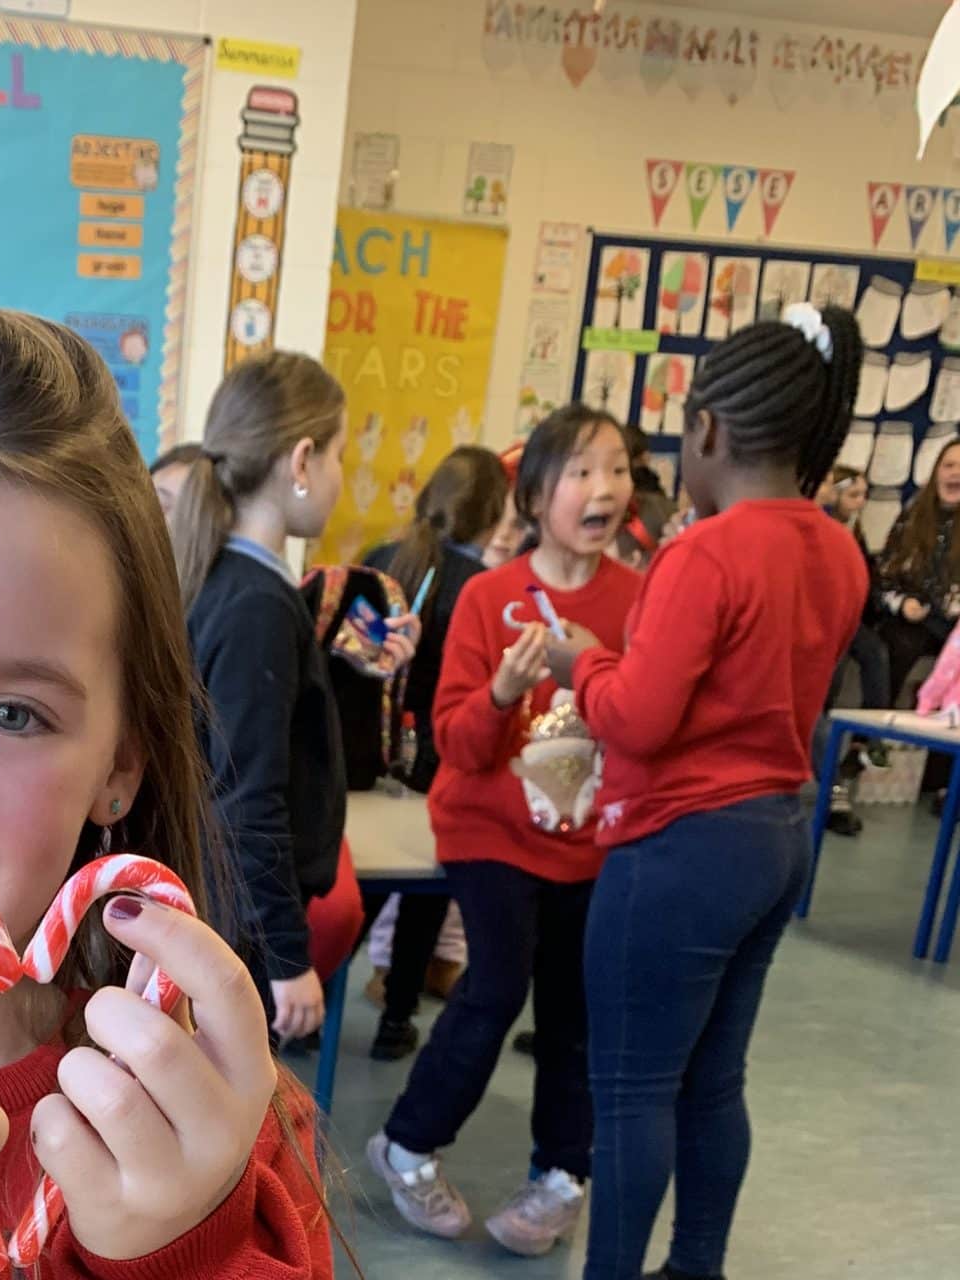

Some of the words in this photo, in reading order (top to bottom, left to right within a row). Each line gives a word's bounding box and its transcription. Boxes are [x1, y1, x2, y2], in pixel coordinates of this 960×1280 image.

[657, 167, 780, 200] SESE
[327, 289, 376, 335] OR
[413, 290, 469, 342] THE
